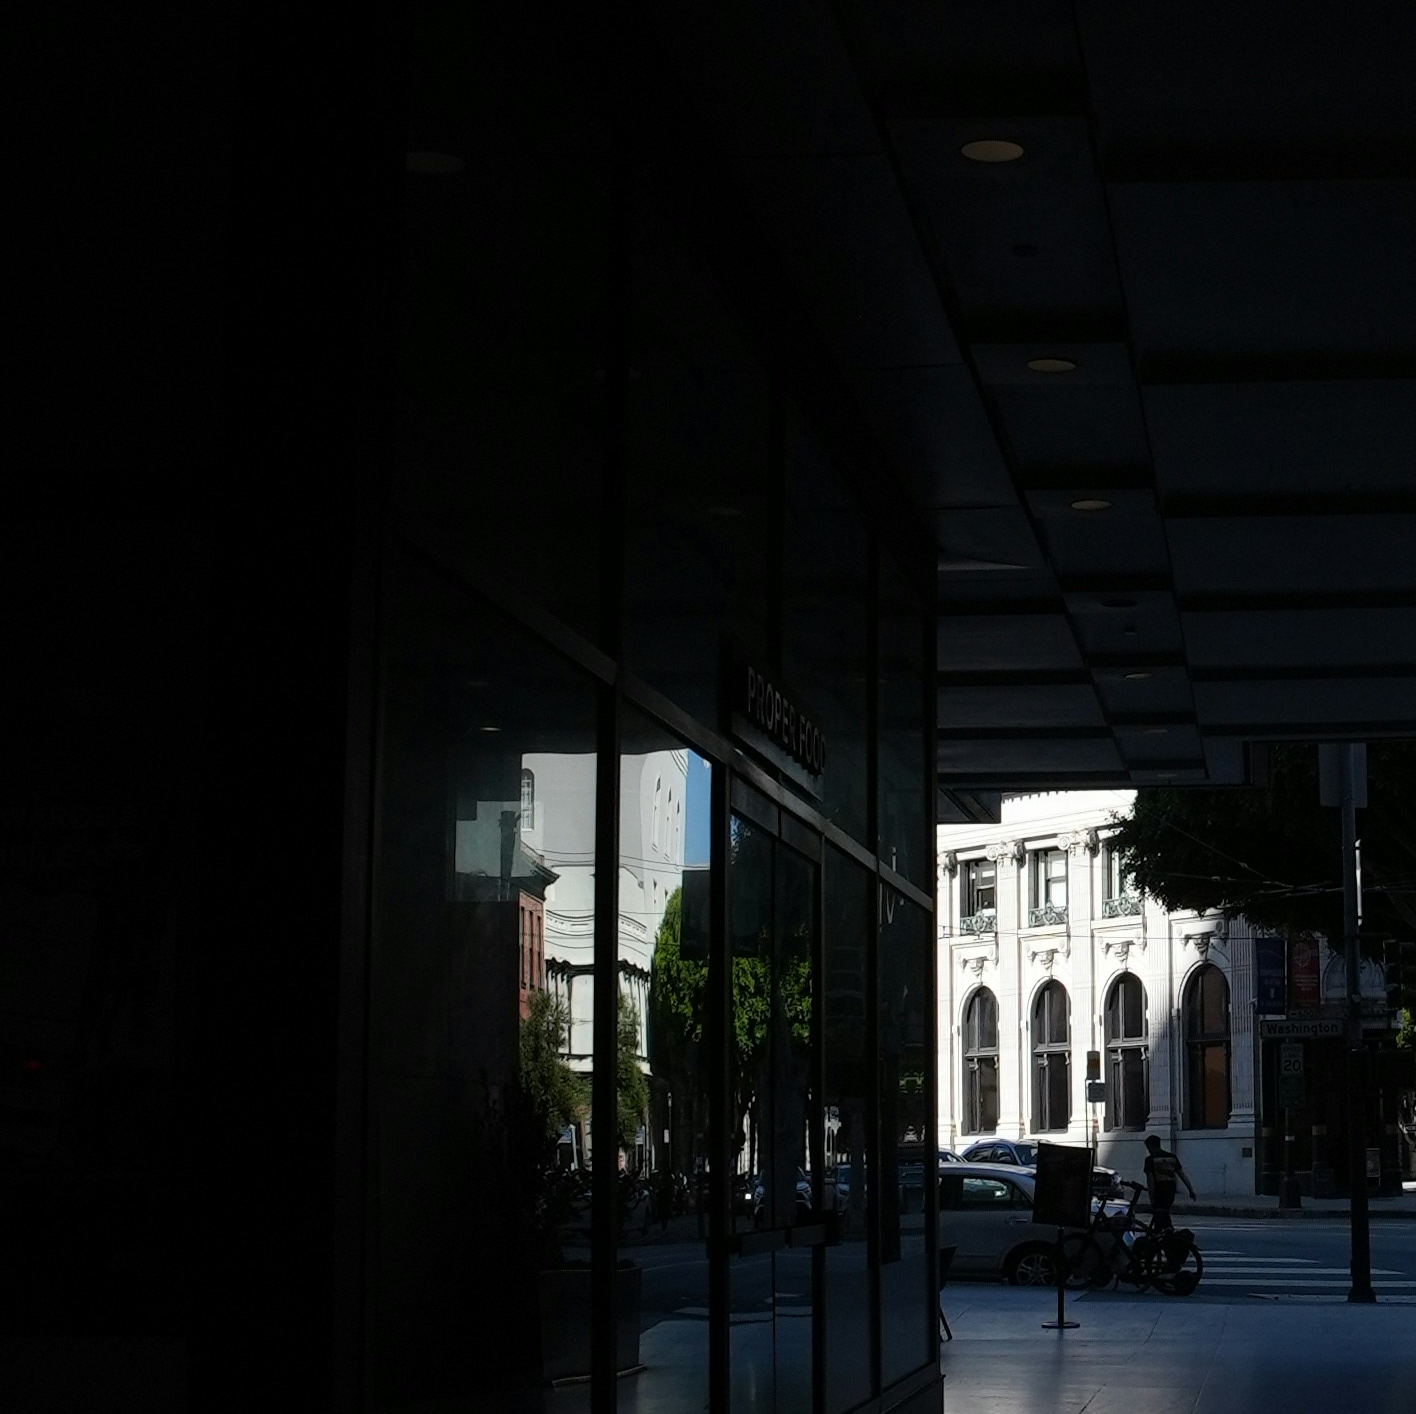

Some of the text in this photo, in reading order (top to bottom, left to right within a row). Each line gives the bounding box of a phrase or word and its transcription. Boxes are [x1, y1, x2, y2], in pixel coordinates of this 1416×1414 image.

[747, 666, 797, 752] PROPER
[1266, 1022, 1339, 1037] Washington
[1283, 1059, 1302, 1073] 20
